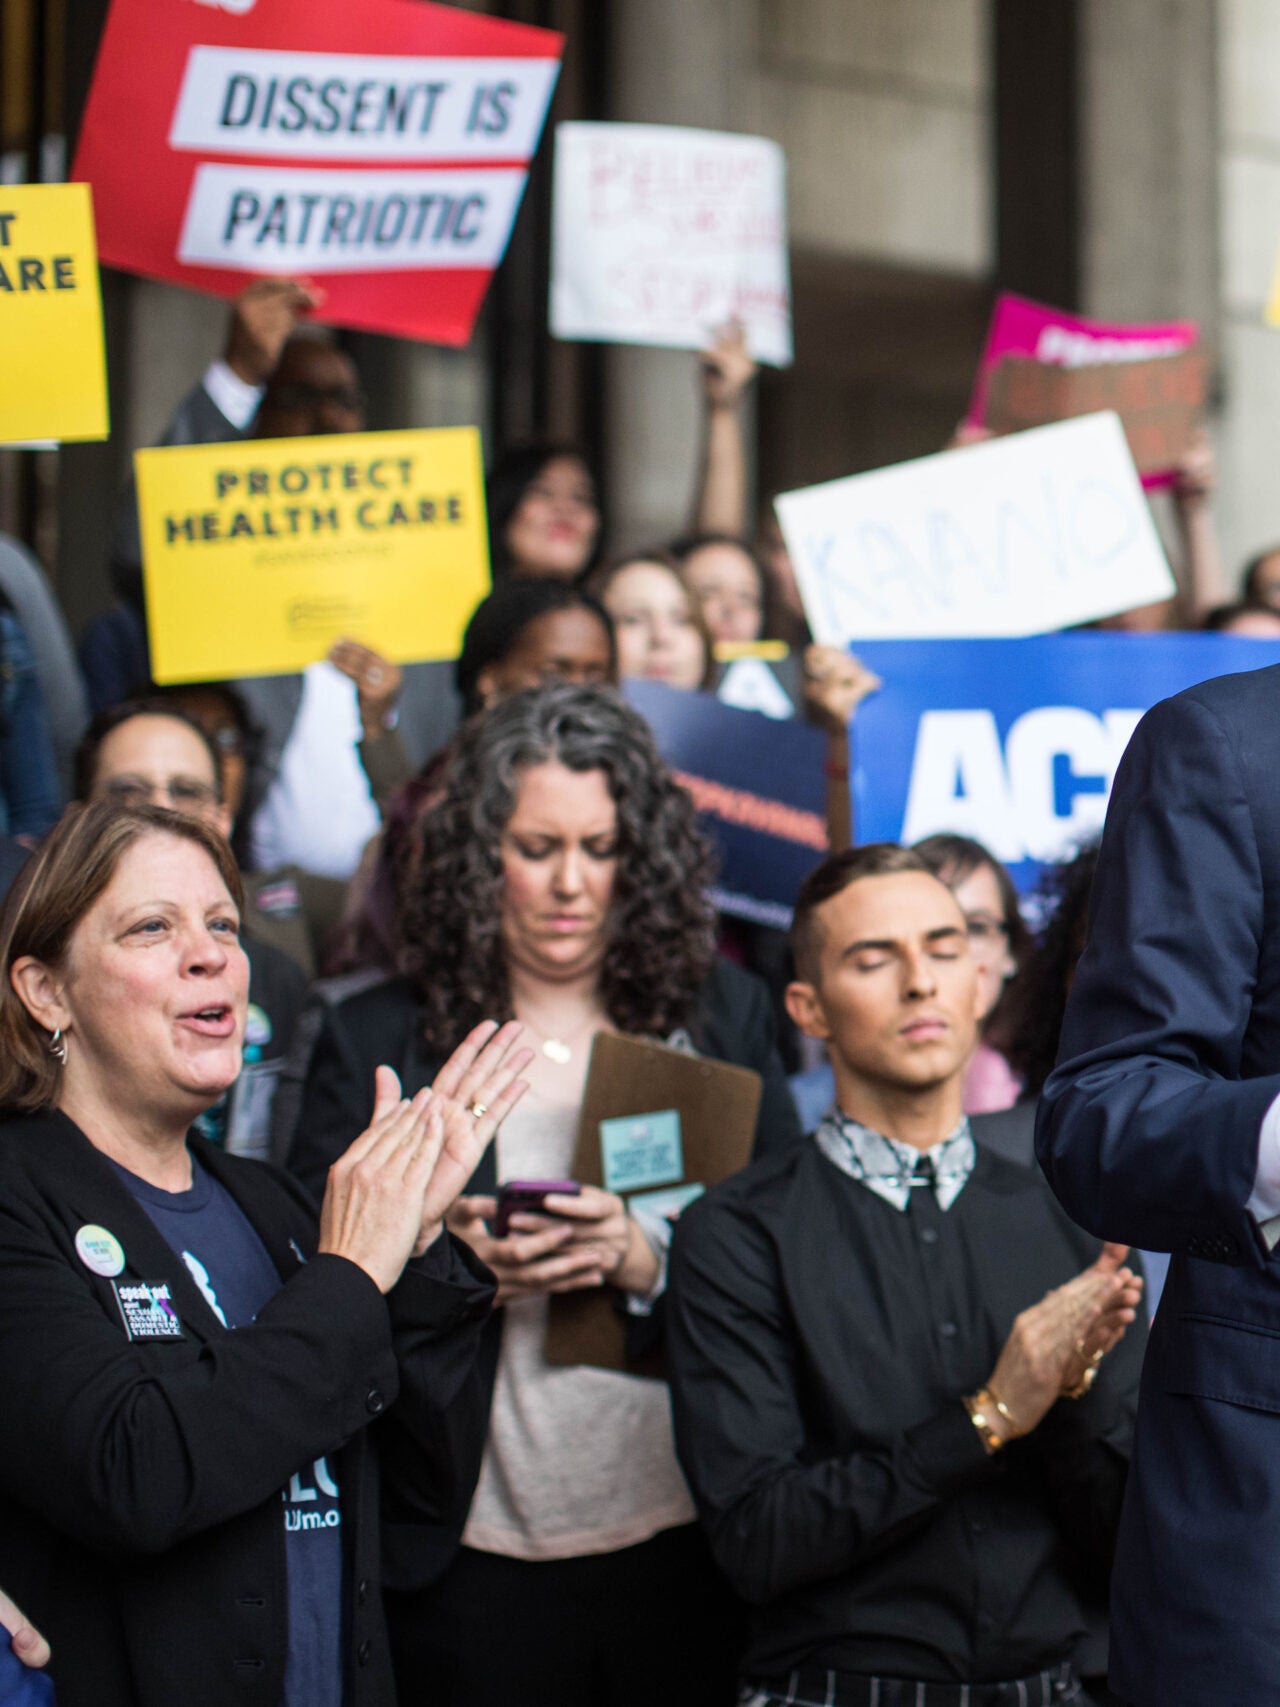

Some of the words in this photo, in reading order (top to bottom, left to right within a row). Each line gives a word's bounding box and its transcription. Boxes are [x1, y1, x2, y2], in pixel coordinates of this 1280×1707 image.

[219, 73, 446, 137] DISSENT
[465, 81, 517, 137] IS
[224, 189, 485, 246] PATRIOTIC
[215, 458, 412, 497] PROTECT
[163, 507, 339, 543] HEALTH
[354, 498, 463, 532] CARE
